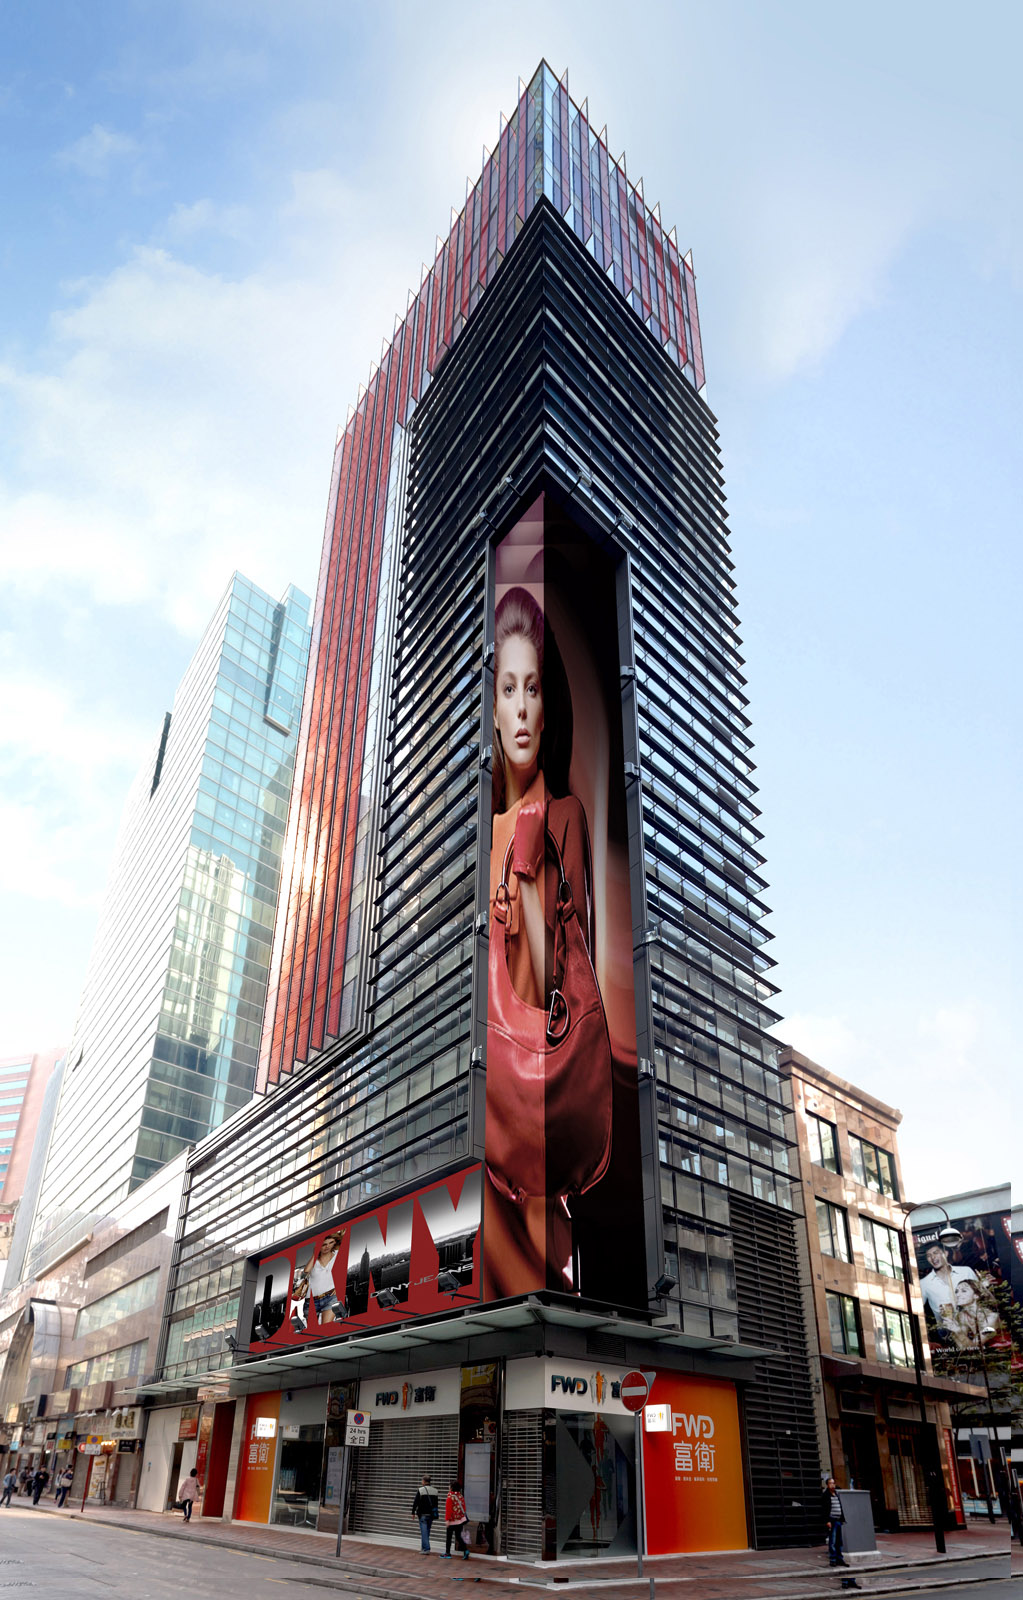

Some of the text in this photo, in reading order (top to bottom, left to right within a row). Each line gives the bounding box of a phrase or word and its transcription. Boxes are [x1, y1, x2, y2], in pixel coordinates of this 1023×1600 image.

[250, 1169, 481, 1343] DKNY
[552, 1375, 588, 1394] FWD
[376, 1391, 399, 1406] FWD
[672, 1413, 714, 1438] FWD
[350, 1435, 365, 1444] 全日
[249, 1443, 270, 1463] 富衛
[673, 1440, 715, 1472] 富衛
